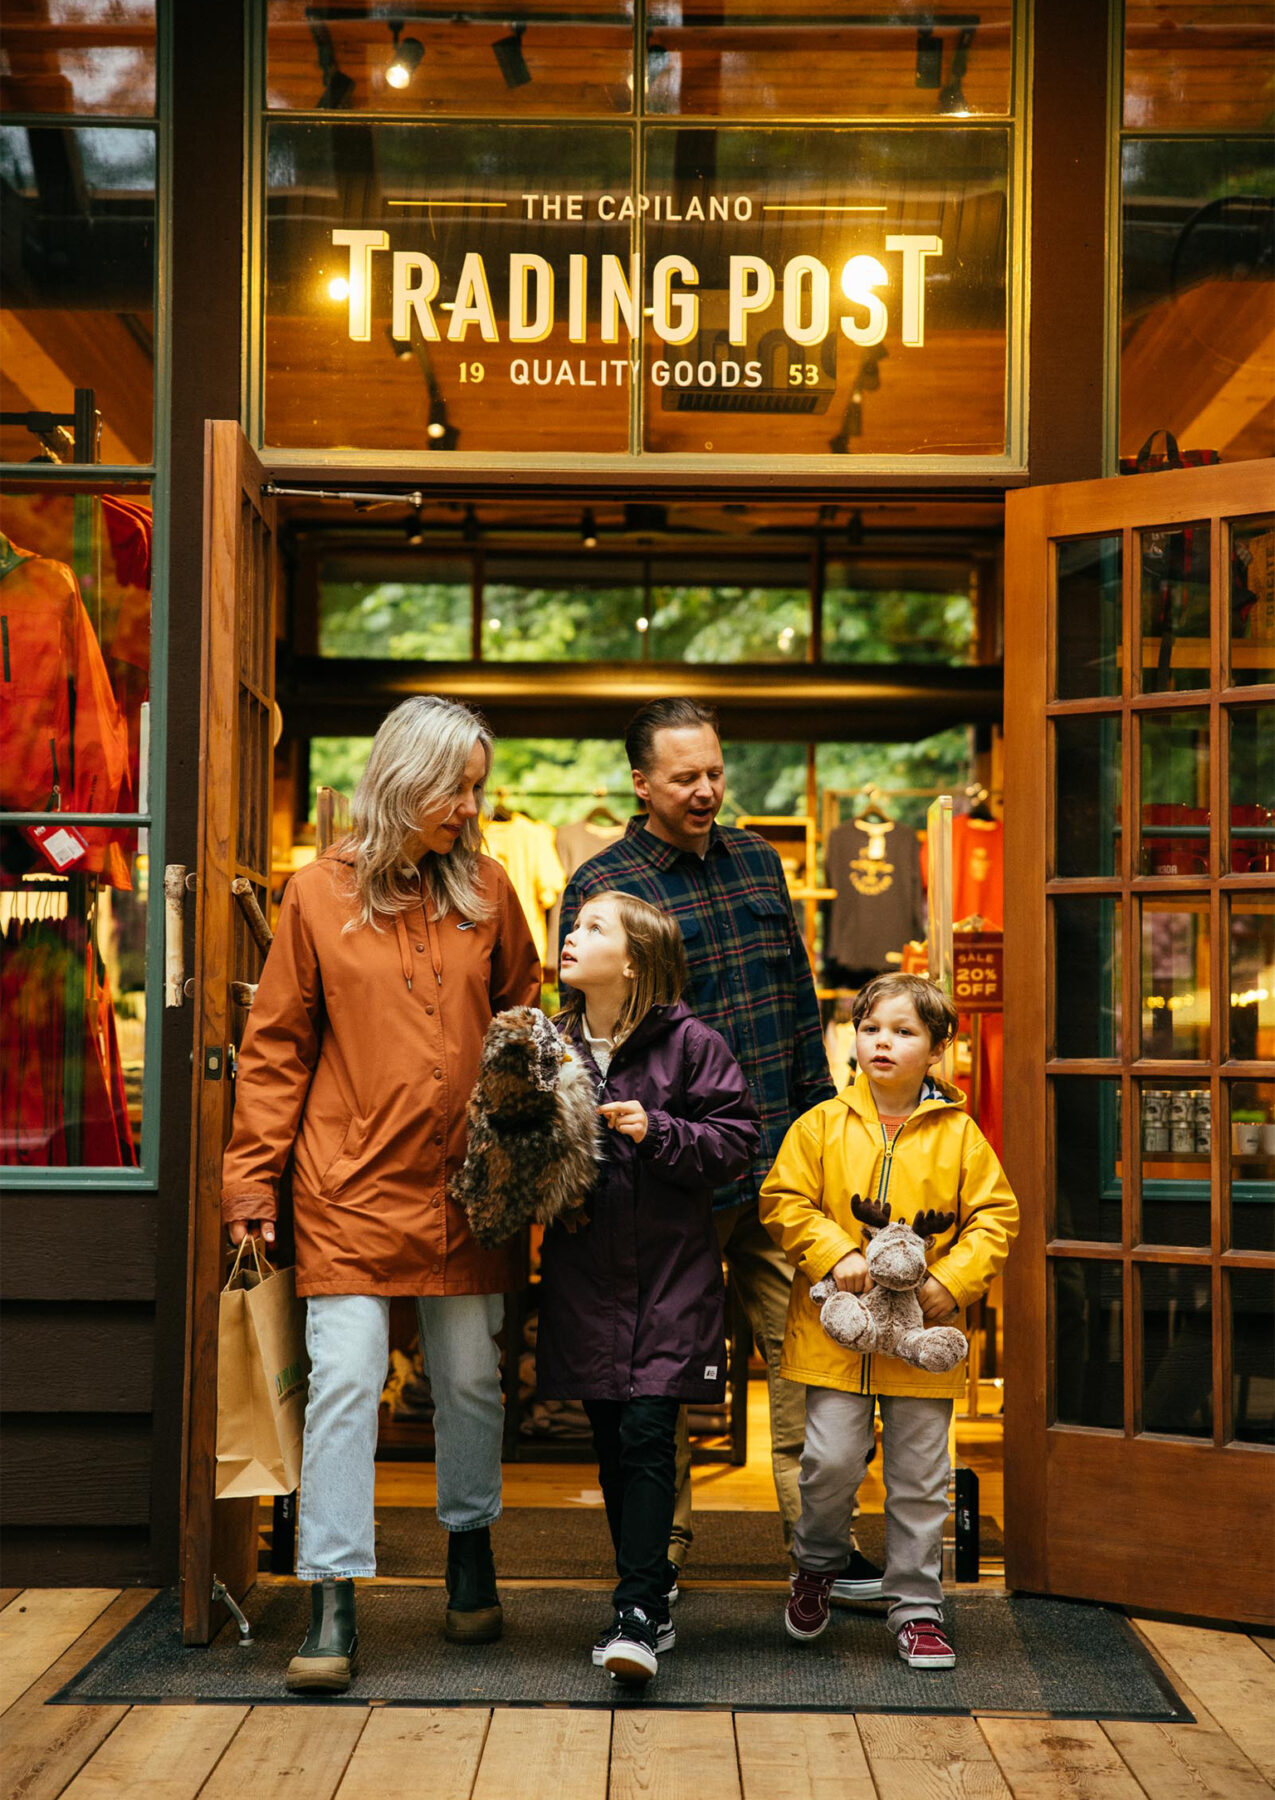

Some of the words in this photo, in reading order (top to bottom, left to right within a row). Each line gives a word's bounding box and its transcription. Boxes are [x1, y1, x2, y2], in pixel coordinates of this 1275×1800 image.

[522, 194, 583, 220] THE
[598, 194, 752, 221] CAPILANO
[332, 229, 699, 346] TRADING
[729, 235, 943, 347] POST
[459, 362, 485, 383] 19
[509, 359, 640, 387] QUALITY
[651, 360, 762, 387] GOODS
[788, 364, 819, 386] 53
[958, 952, 994, 964] SALE
[956, 968, 997, 981] 20%
[956, 983, 997, 996] OFF
